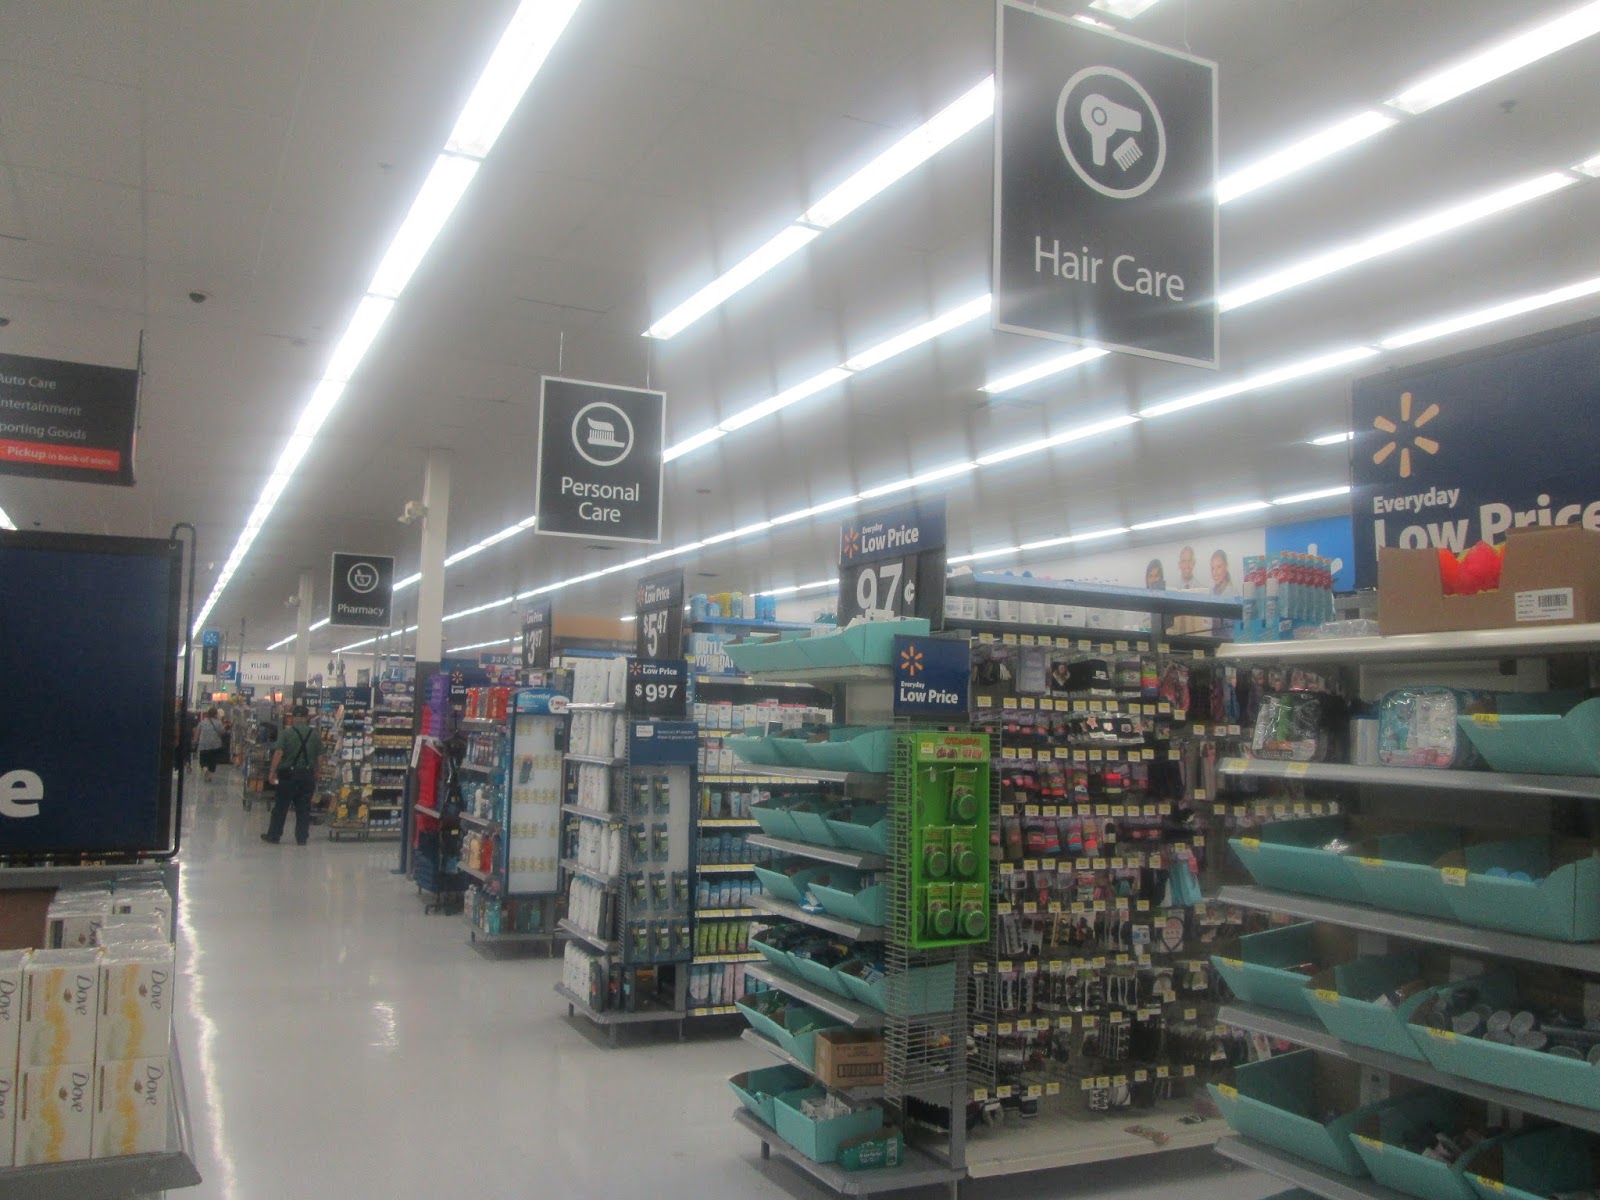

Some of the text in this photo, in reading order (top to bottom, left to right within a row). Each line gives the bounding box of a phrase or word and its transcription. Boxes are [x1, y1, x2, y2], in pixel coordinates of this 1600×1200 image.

[1035, 236, 1184, 301] Hair Care
[29, 376, 57, 390] Care
[0, 400, 81, 416] ntertainment
[0, 423, 87, 440] porting Goods
[8, 446, 46, 460] Pickup
[561, 476, 640, 501] Personal
[1373, 486, 1460, 514] Everyday
[579, 502, 621, 522] Care
[862, 523, 883, 534] Everyday
[862, 525, 919, 553] Low Price
[645, 591, 656, 604] Low
[656, 587, 670, 602] Price
[337, 603, 384, 616] Pharmacy
[642, 667, 678, 676] Low Price
[901, 681, 925, 689] Everyday
[900, 688, 958, 704] Low Price
[75, 975, 94, 1016] Dove
[151, 969, 168, 1010] Dove
[0, 979, 17, 1021] Dove
[71, 1072, 90, 1113] Dove
[146, 1065, 164, 1106] Dove
